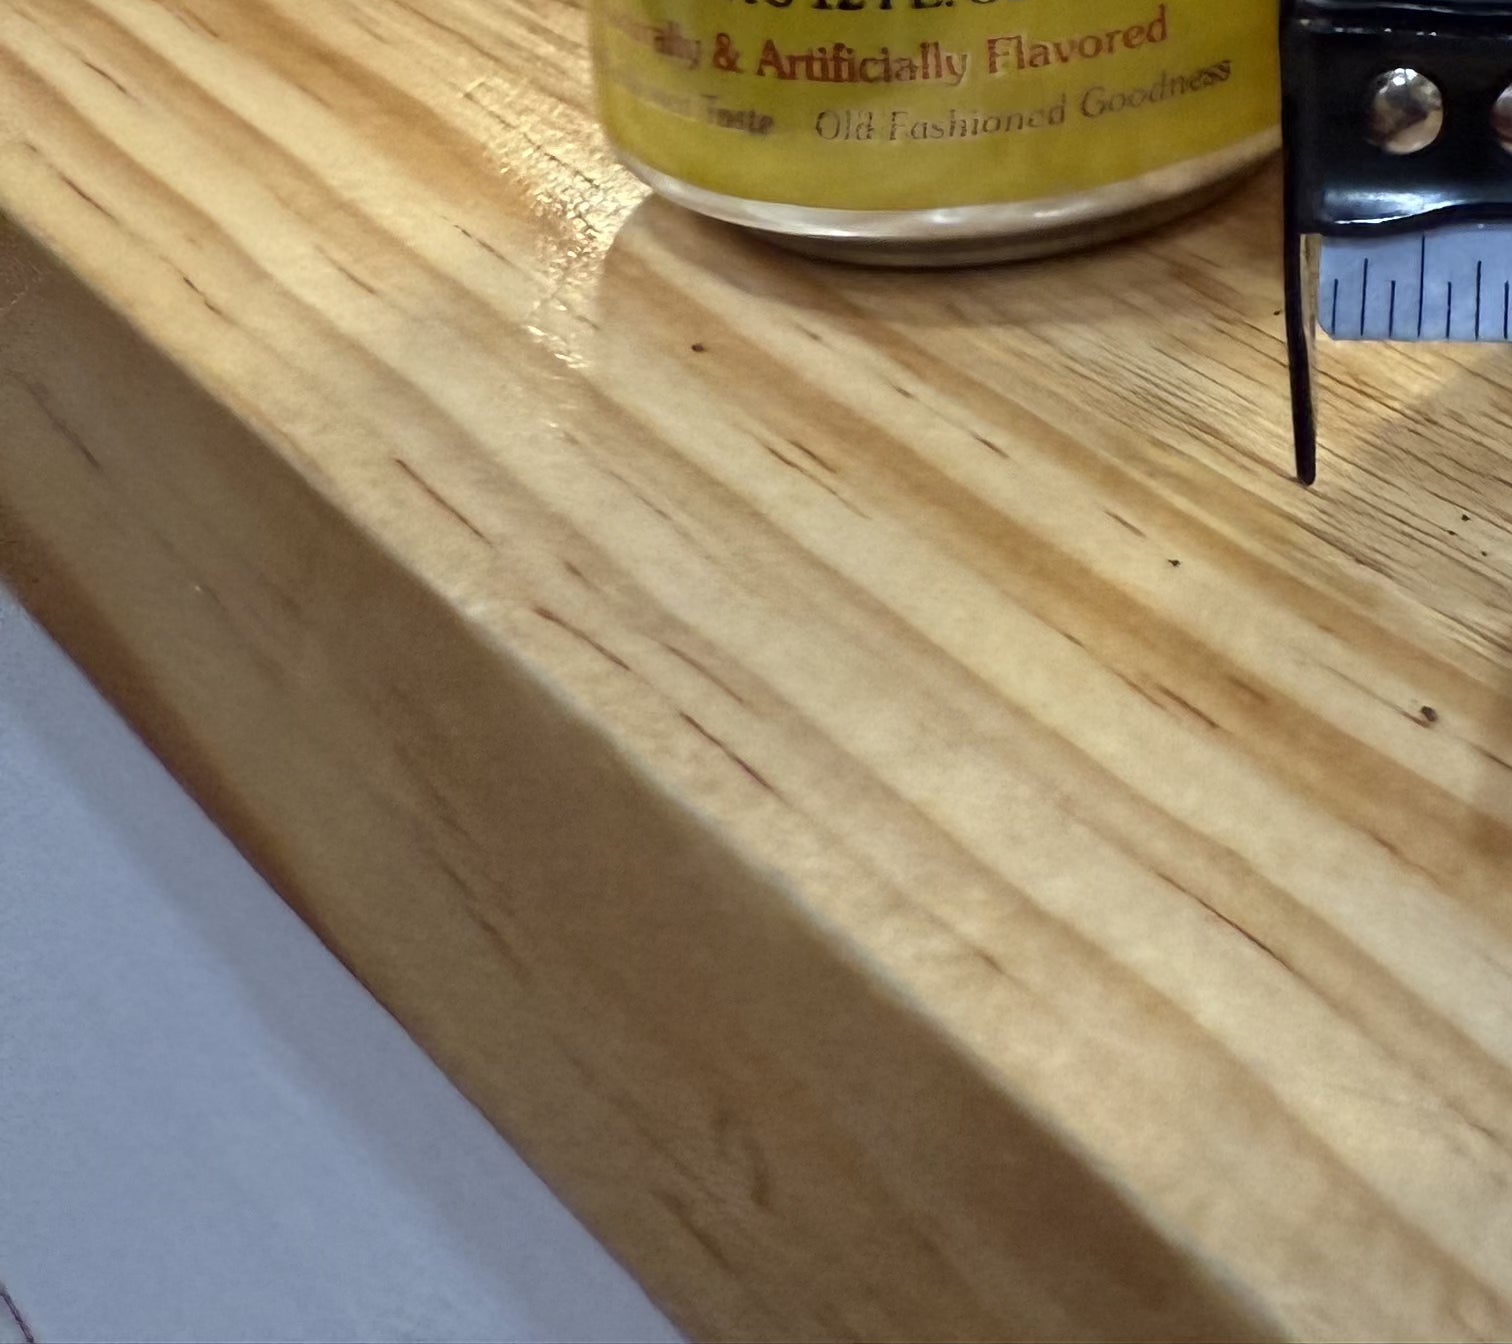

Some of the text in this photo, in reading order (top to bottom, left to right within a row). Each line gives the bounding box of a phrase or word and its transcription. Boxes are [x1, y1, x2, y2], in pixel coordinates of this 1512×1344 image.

[711, 32, 744, 73] &
[756, 38, 968, 87] Artificially
[987, 3, 1169, 75] Flavored
[814, 110, 873, 142] Old
[887, 92, 1066, 142] Fashioned
[1079, 59, 1232, 119] Goodness
